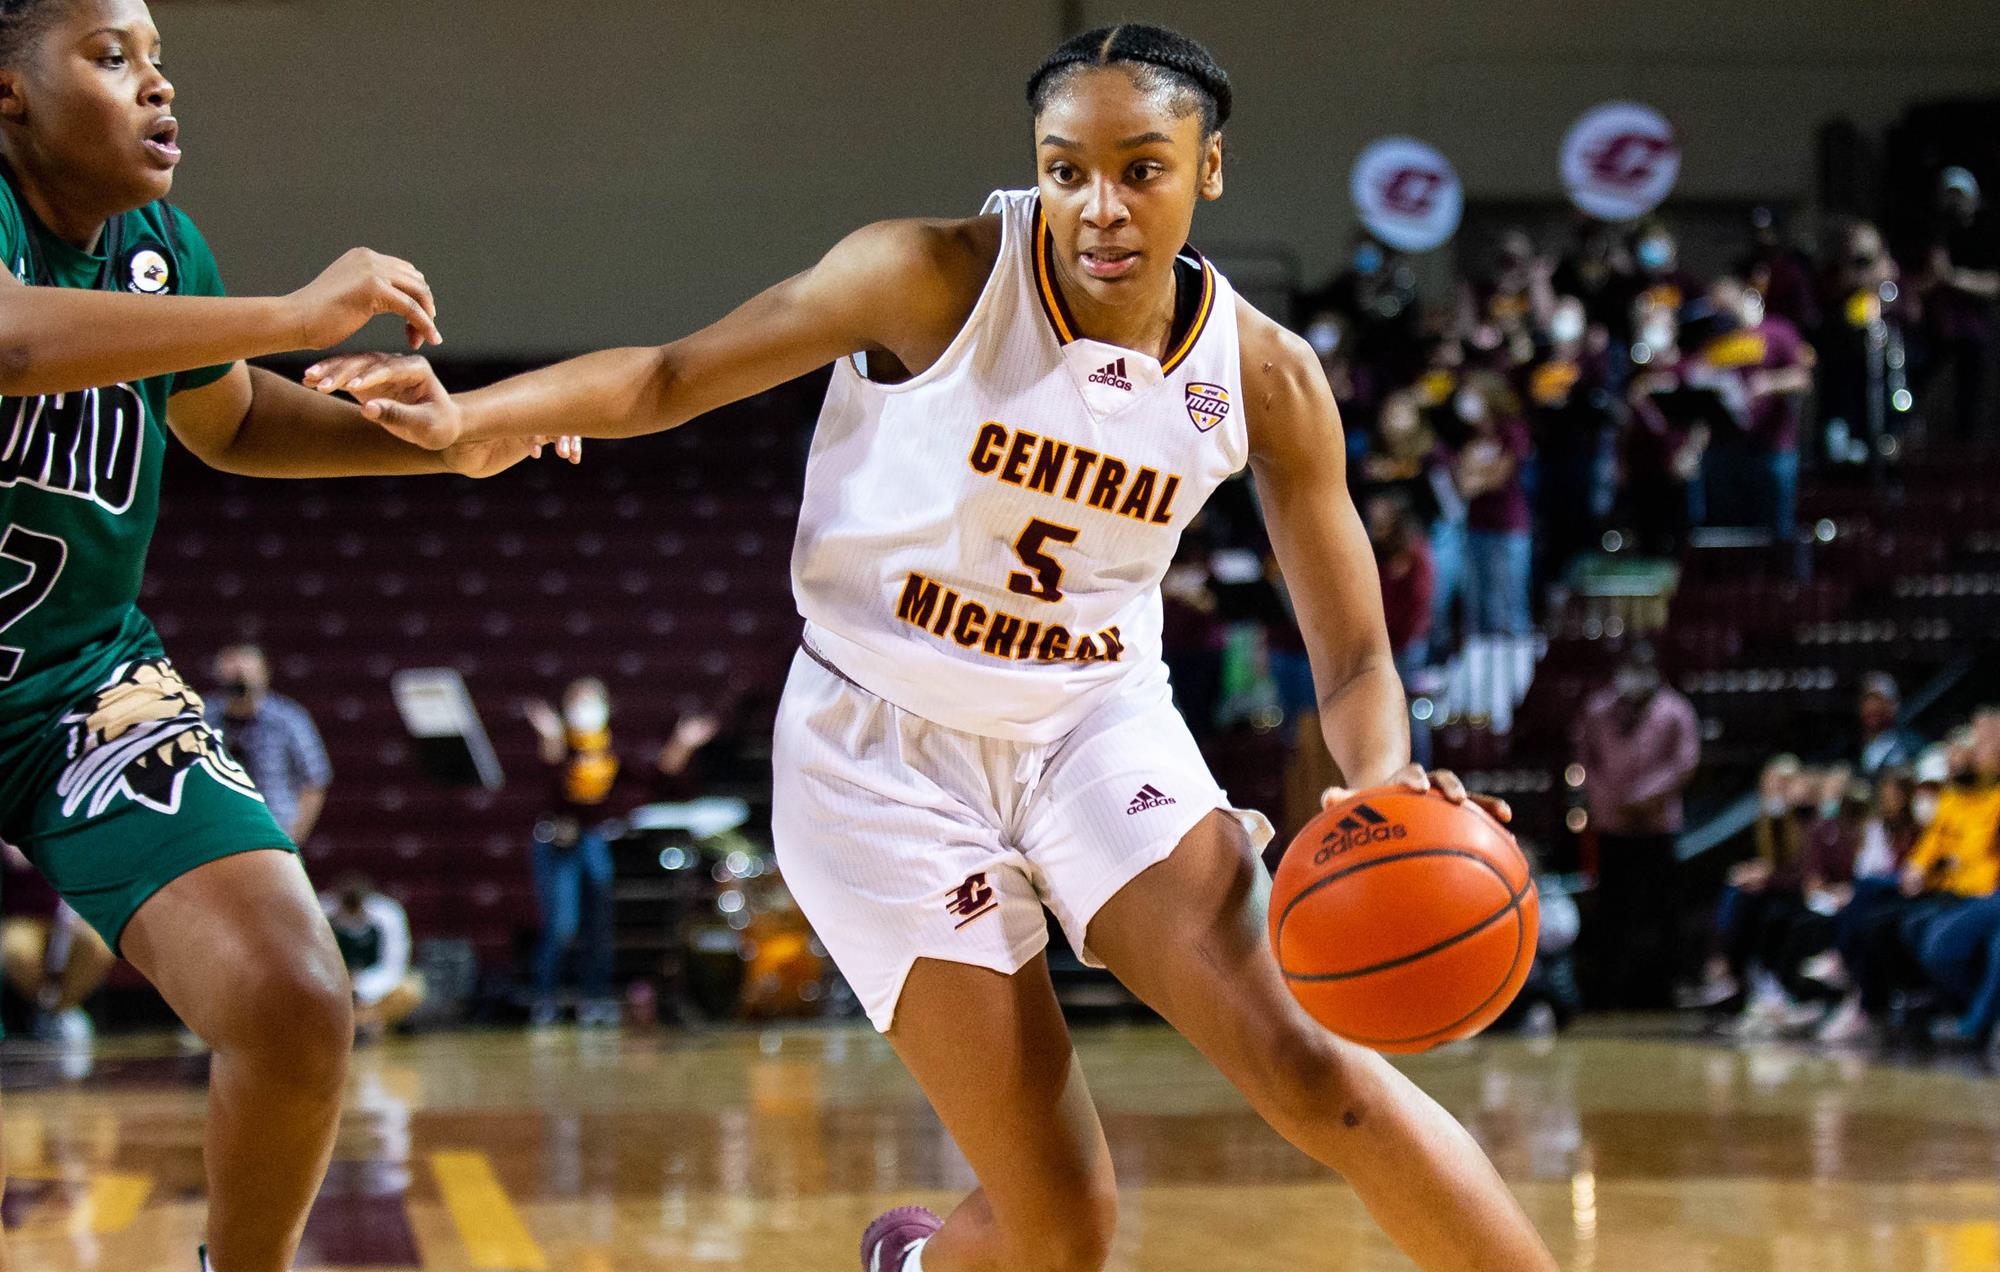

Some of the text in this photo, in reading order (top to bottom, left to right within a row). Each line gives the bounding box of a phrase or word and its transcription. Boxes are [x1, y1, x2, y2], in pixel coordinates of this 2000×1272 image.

[1088, 373, 1132, 391] adidas
[1185, 394, 1229, 417] MAC
[968, 420, 1181, 526] CENTRAL
[1007, 516, 1080, 603] 5
[896, 570, 1125, 662] MICHIGAN
[1126, 797, 1176, 815] adidas
[1314, 824, 1407, 865] adidas
